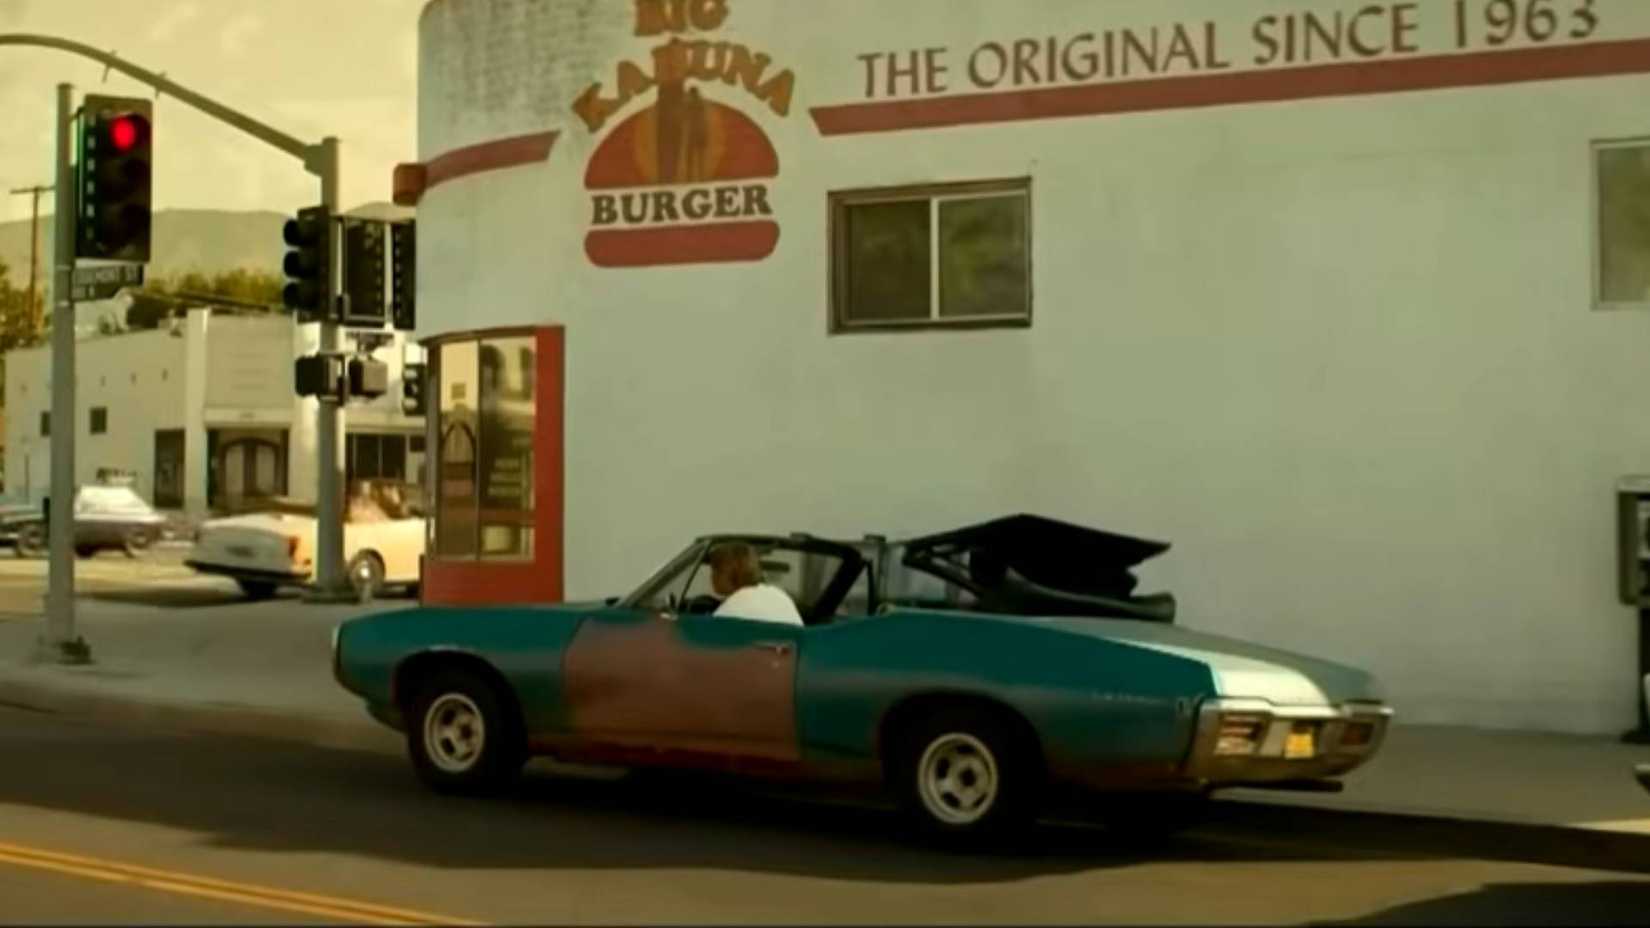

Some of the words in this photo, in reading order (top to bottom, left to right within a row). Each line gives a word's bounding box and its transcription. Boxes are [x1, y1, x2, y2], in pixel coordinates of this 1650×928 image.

[857, 47, 947, 98] THE
[967, 21, 1230, 88] ORIGINAL
[1252, 3, 1418, 65] SINCE
[1453, 0, 1598, 48] 1963
[591, 184, 773, 225] BURGER
